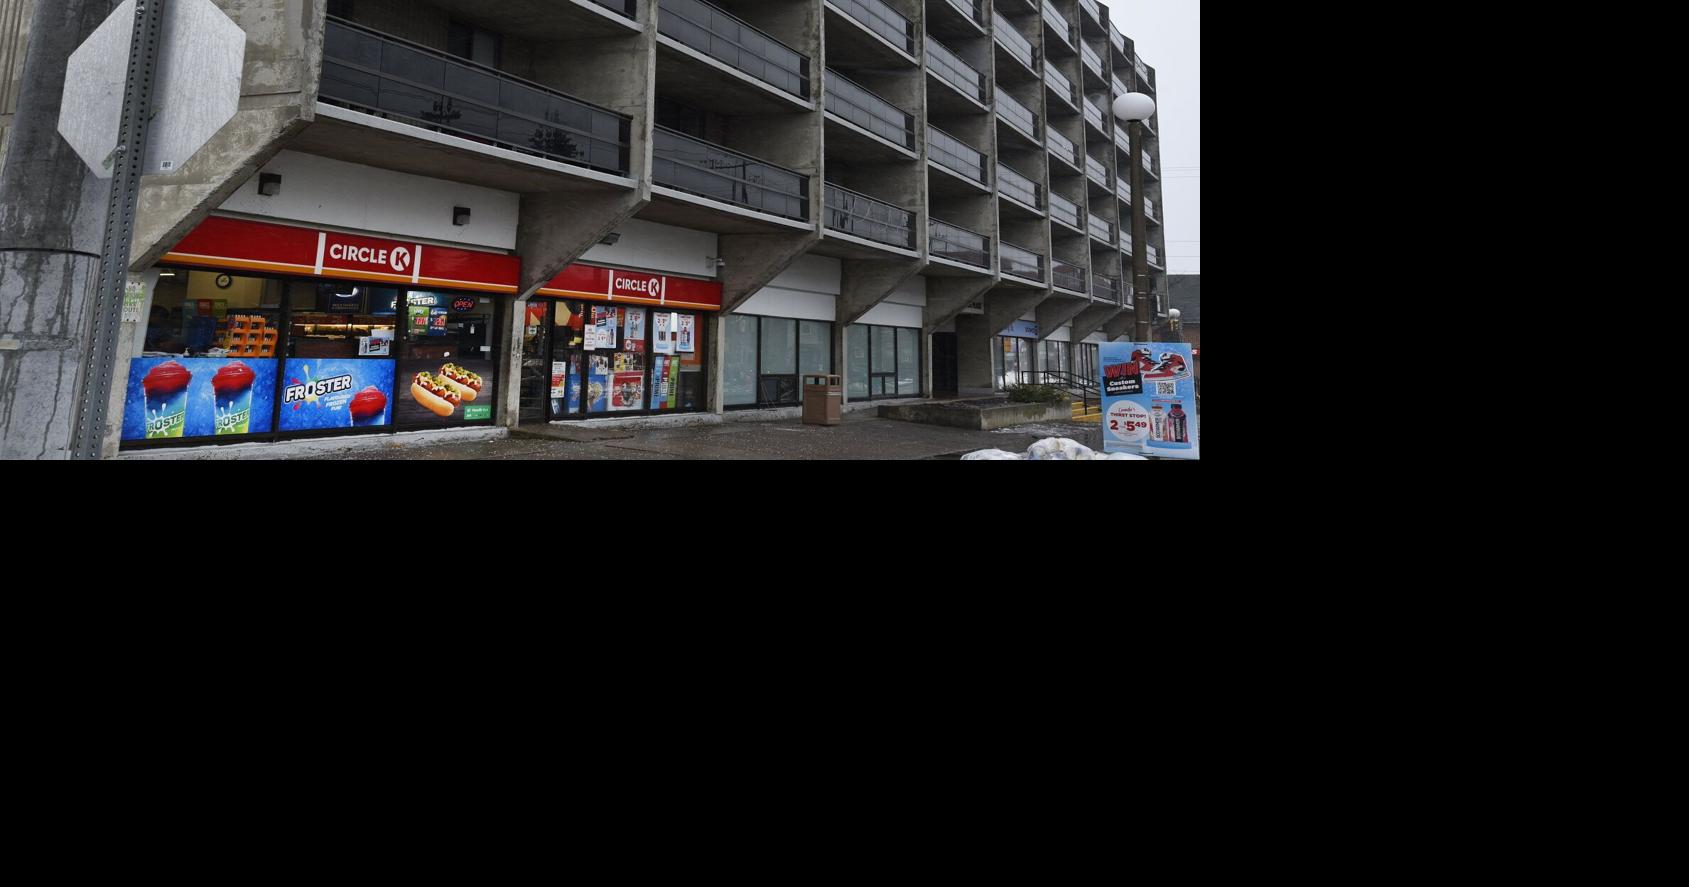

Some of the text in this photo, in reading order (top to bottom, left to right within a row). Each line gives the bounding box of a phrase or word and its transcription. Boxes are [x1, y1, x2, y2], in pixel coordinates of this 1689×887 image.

[329, 243, 410, 271] CIRCLE K
[615, 277, 659, 296] CIRCLE K
[453, 300, 474, 309] OPEN
[1104, 362, 1139, 378] WIN
[285, 375, 352, 402] FROSTER
[1107, 384, 1139, 392] Sneakers
[1109, 379, 1136, 387] Custom
[1110, 420, 1119, 430] 2
